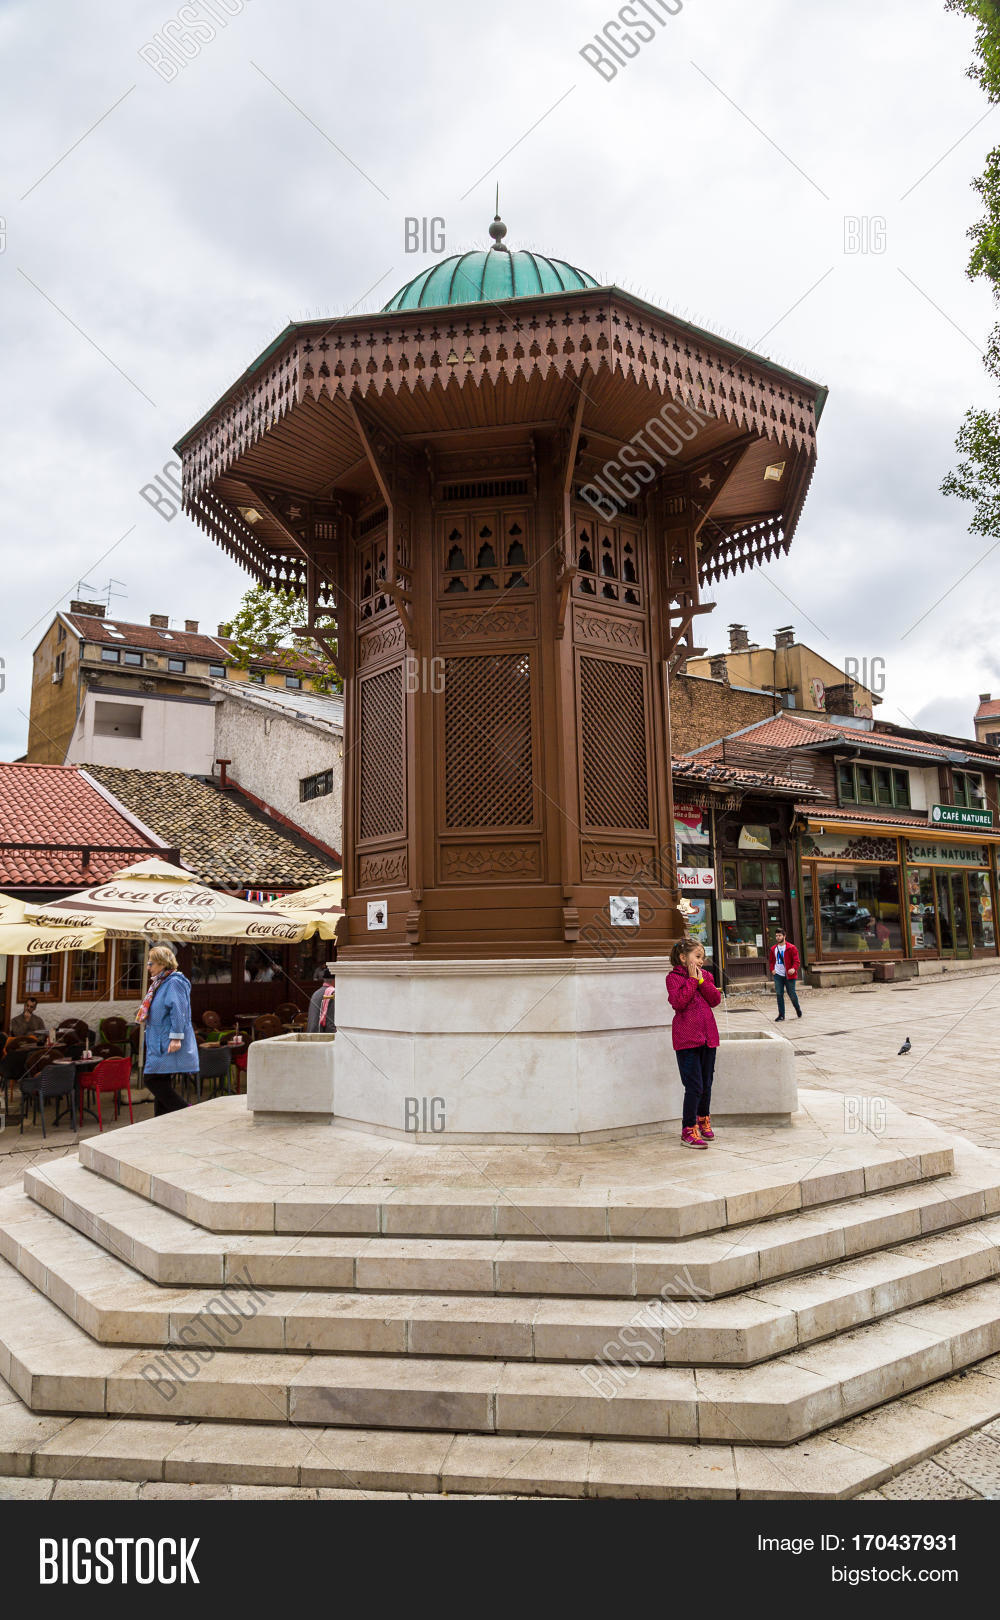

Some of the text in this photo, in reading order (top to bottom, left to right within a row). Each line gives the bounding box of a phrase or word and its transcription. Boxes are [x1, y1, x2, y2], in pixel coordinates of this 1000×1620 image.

[961, 813, 991, 824] NATUREL
[941, 849, 981, 860] NATUREL
[88, 886, 217, 906] Coca-Cola
[144, 916, 202, 933] Coca-Cola
[245, 921, 308, 940] Coca-Cola
[26, 934, 85, 954] Coca-Cola
